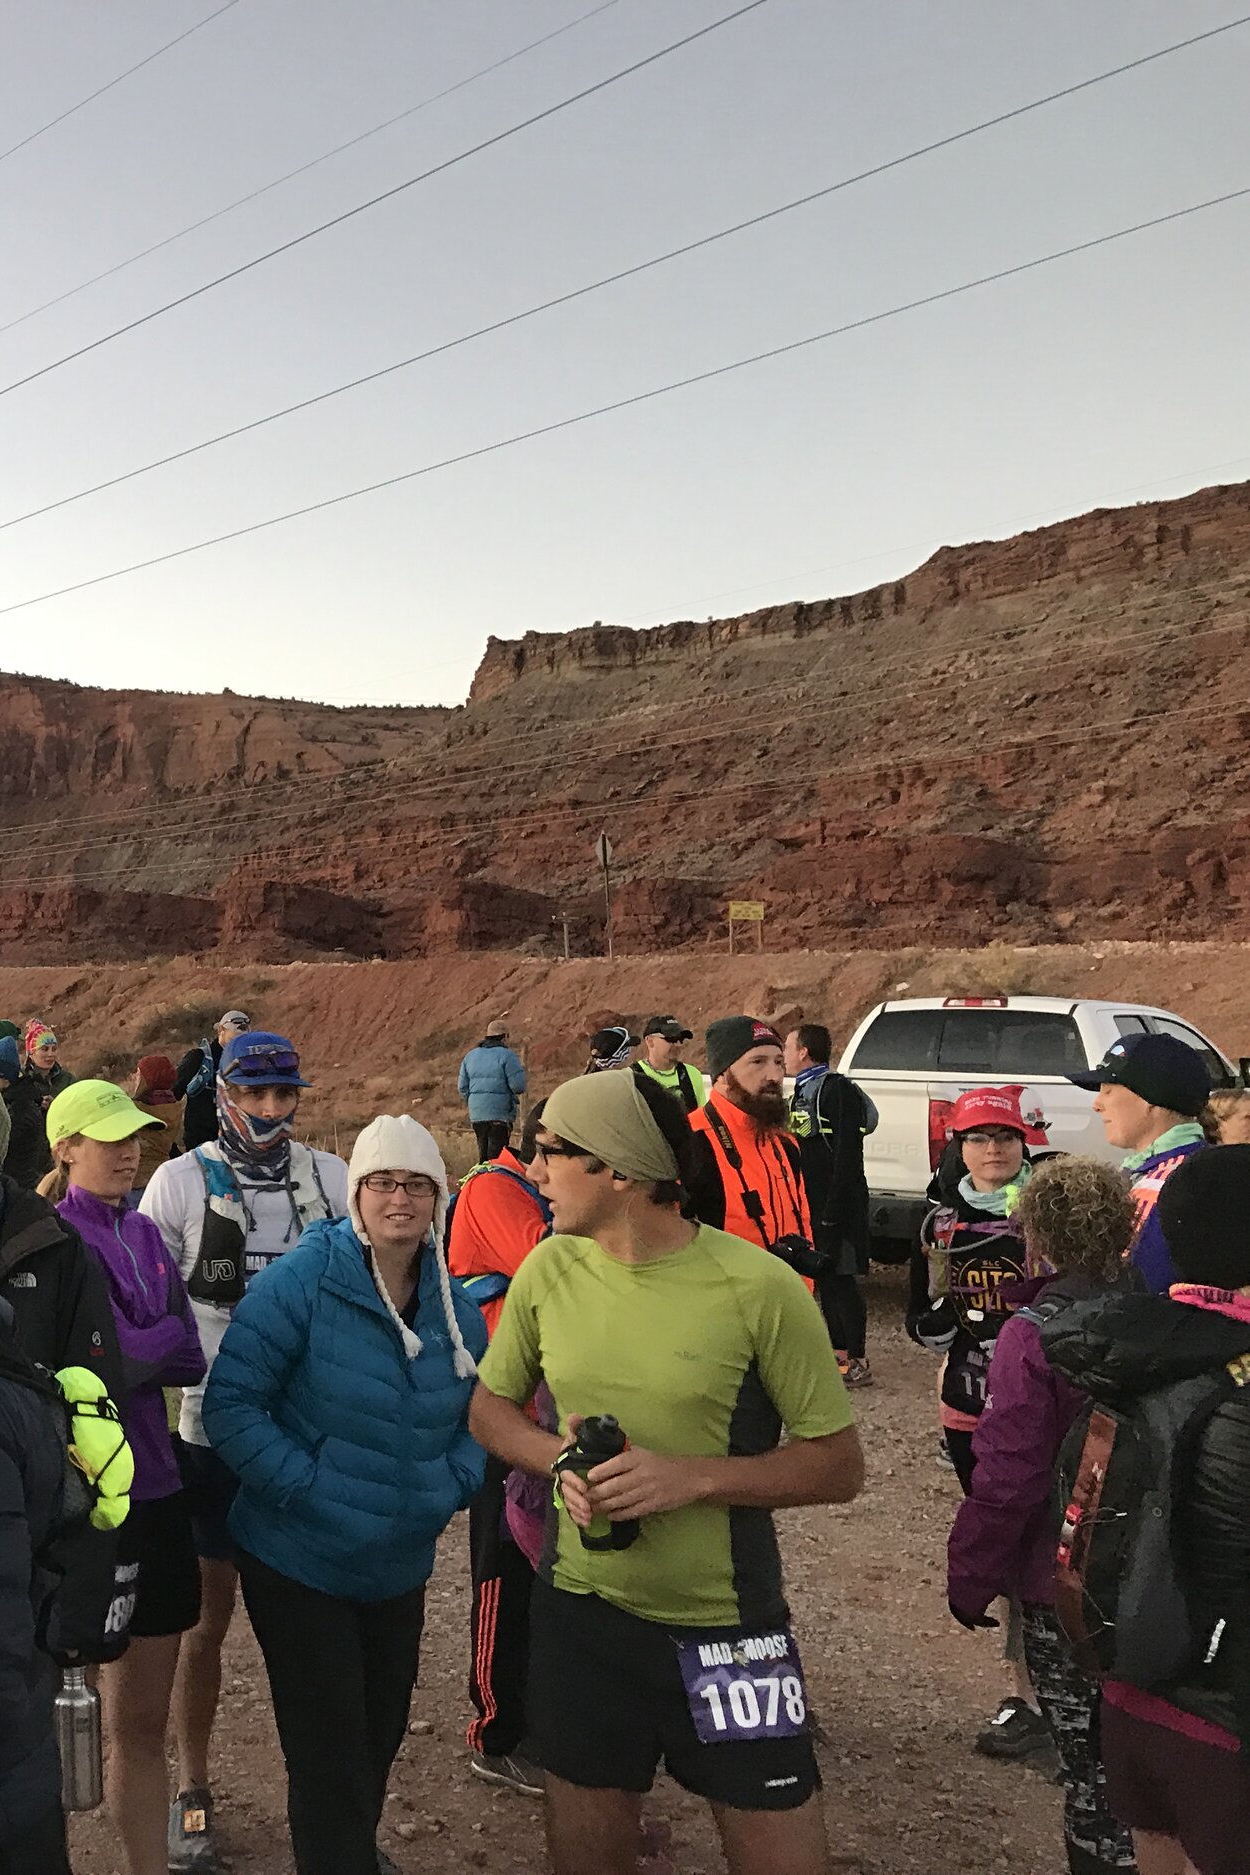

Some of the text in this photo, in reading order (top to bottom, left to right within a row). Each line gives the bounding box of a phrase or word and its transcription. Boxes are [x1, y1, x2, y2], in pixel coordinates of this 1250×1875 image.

[698, 1634, 789, 1667] MAD MOOSE
[700, 1676, 806, 1731] 1078
